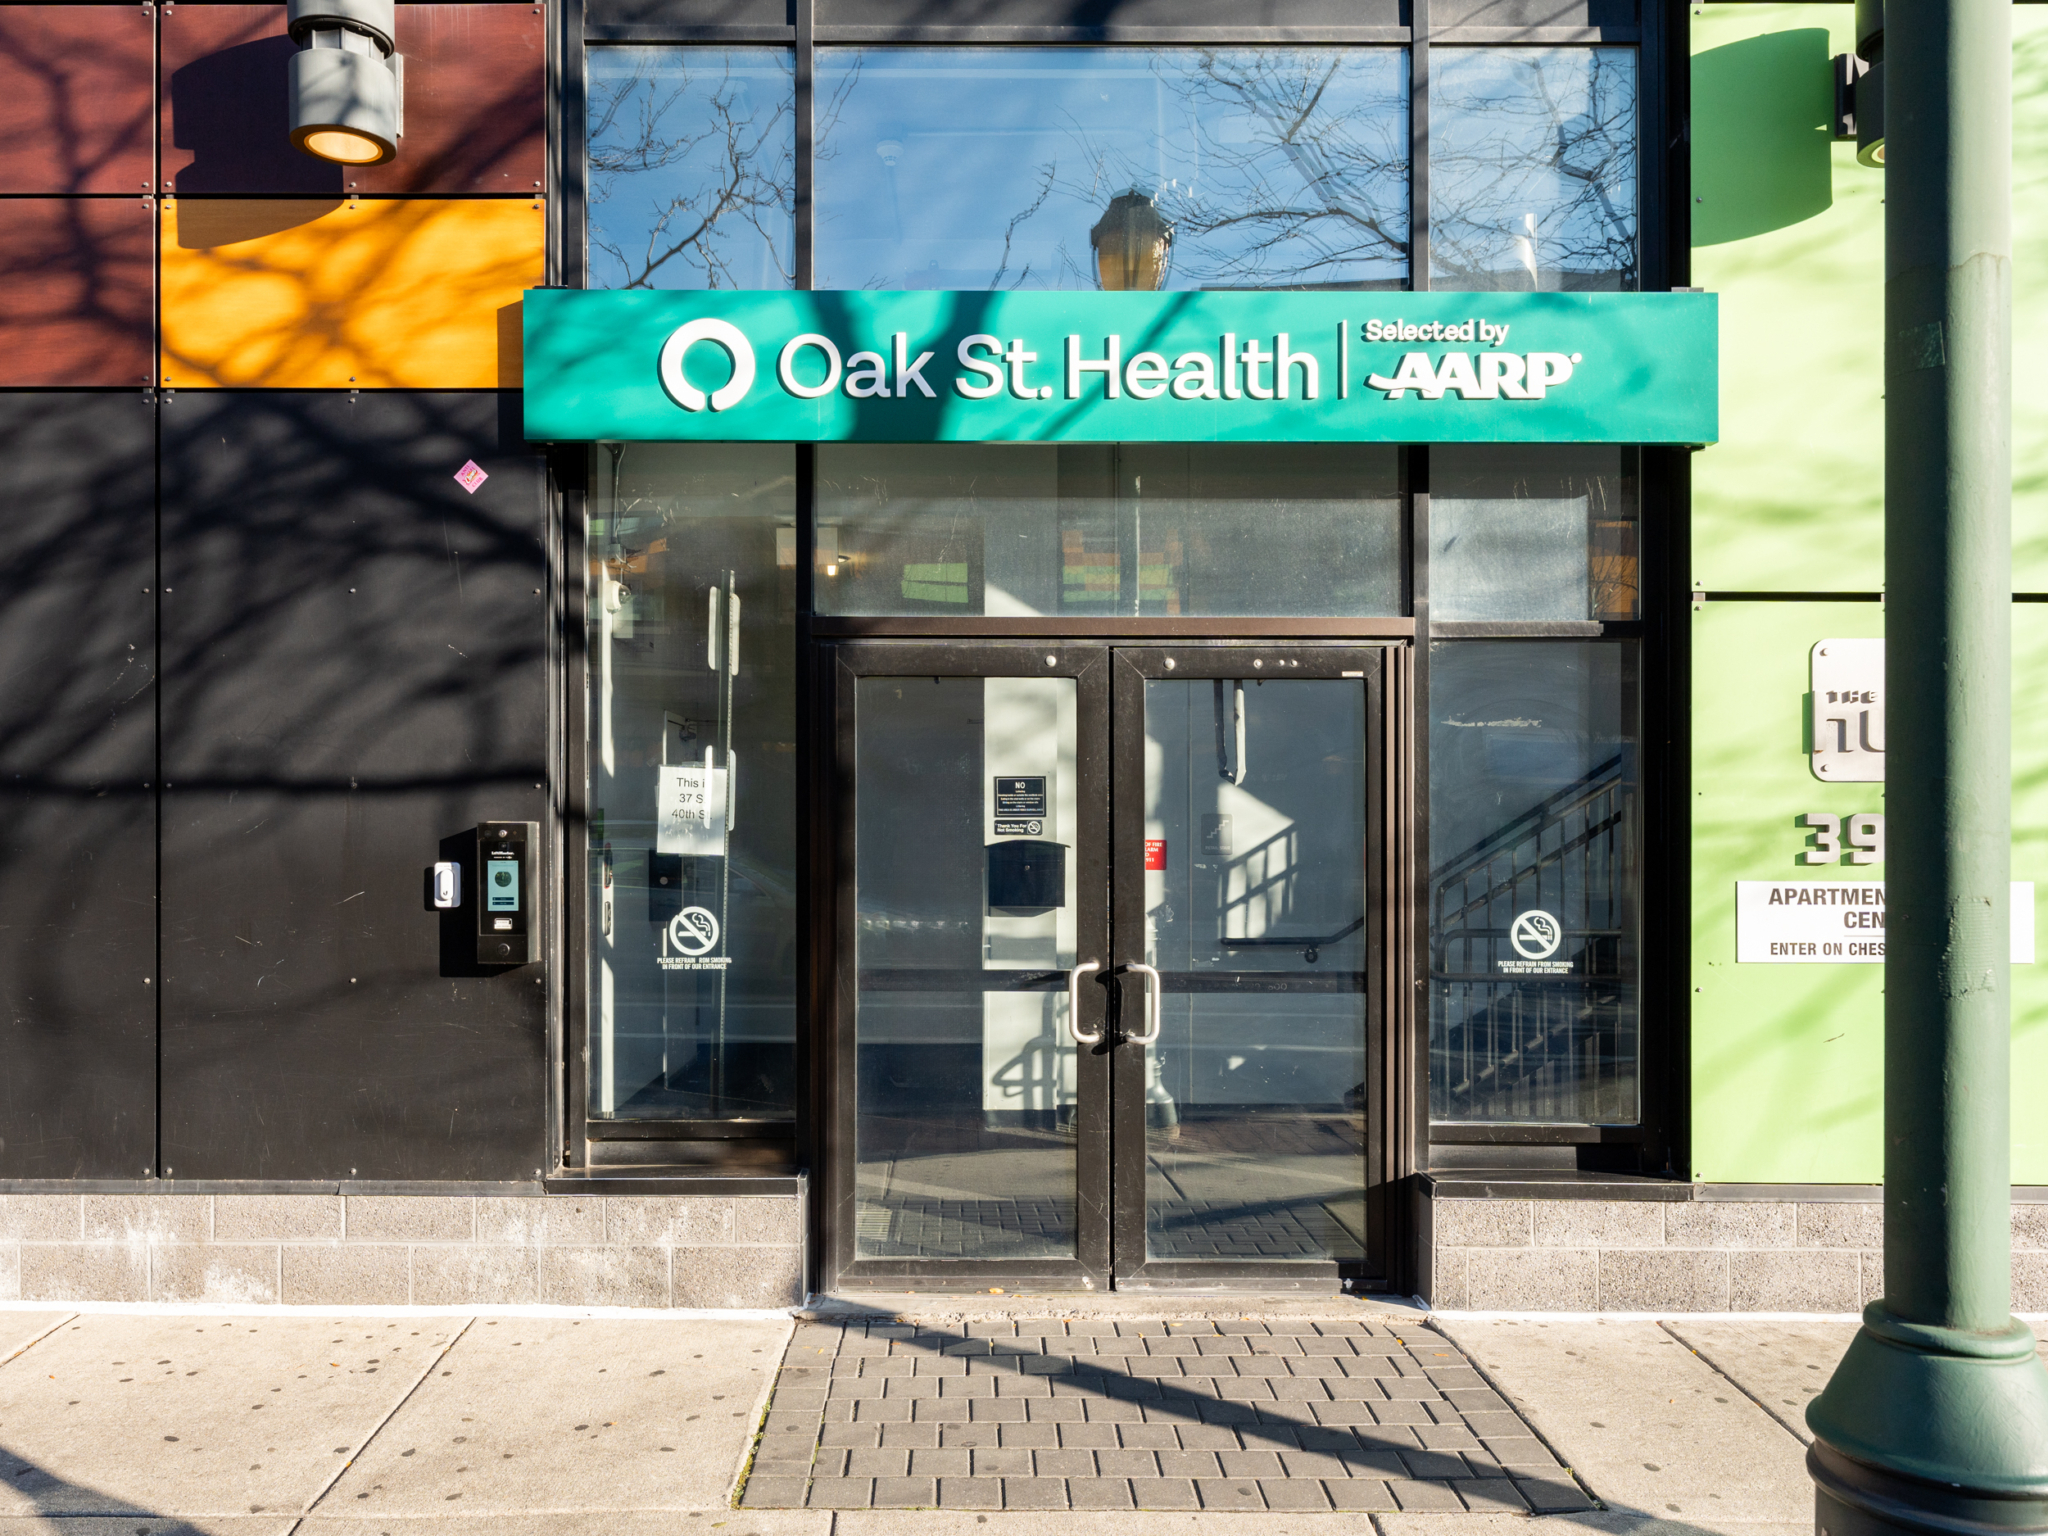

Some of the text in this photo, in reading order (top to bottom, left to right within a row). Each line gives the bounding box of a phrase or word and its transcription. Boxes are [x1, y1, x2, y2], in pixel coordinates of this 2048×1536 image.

[1364, 318, 1510, 346] Selected by
[779, 332, 1319, 400] Oak St. Health
[1366, 352, 1575, 399] AARP
[676, 777, 699, 788] This
[1015, 781, 1026, 789] NO
[679, 793, 692, 803] 37
[671, 808, 695, 819] 40th
[1803, 812, 1885, 864] 39
[1768, 888, 1885, 906] APARTMEN
[1843, 911, 1885, 929] CEN
[1770, 942, 1885, 956] ENTER ON CHES
